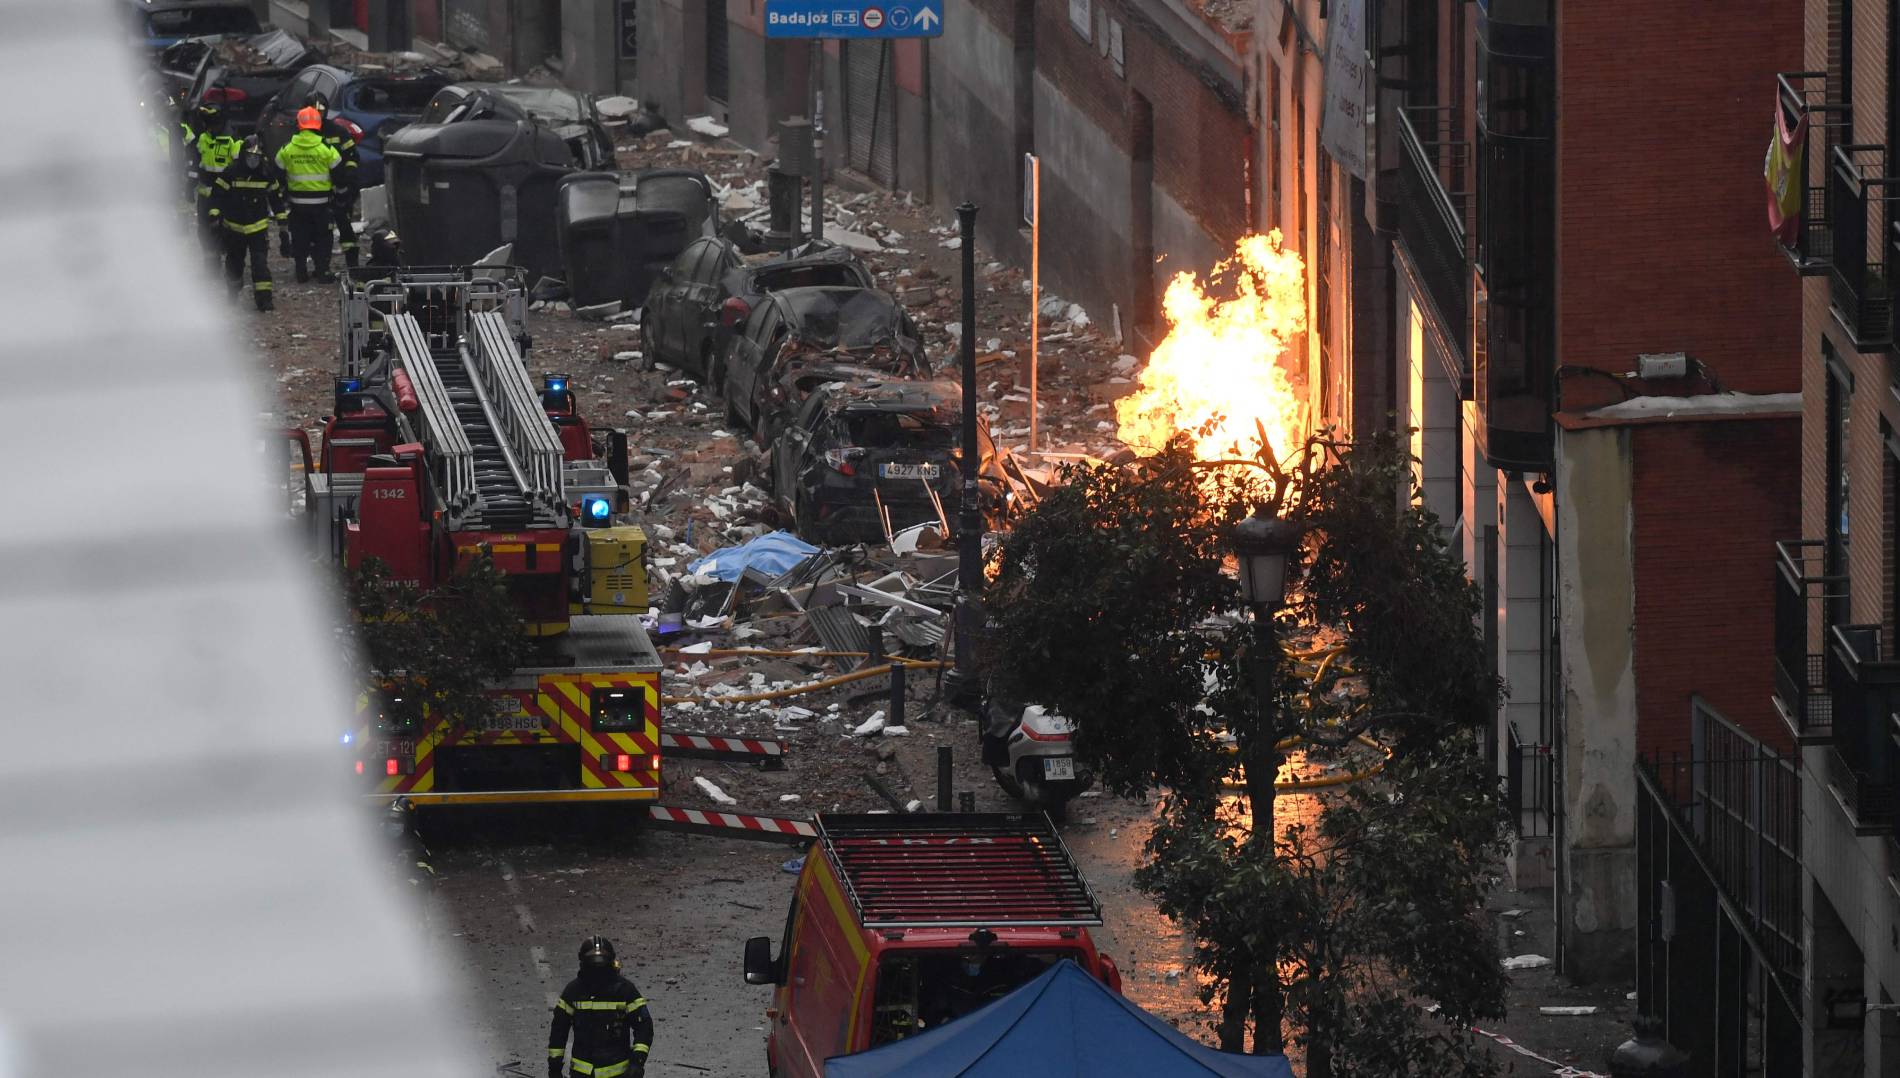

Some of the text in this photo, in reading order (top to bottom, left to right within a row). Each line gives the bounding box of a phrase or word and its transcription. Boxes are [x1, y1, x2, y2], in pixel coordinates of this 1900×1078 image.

[769, 11, 857, 26] Badajoz R-5
[887, 464, 937, 476] 4927 KNS
[372, 488, 405, 499] 1342
[515, 717, 539, 729] HSC
